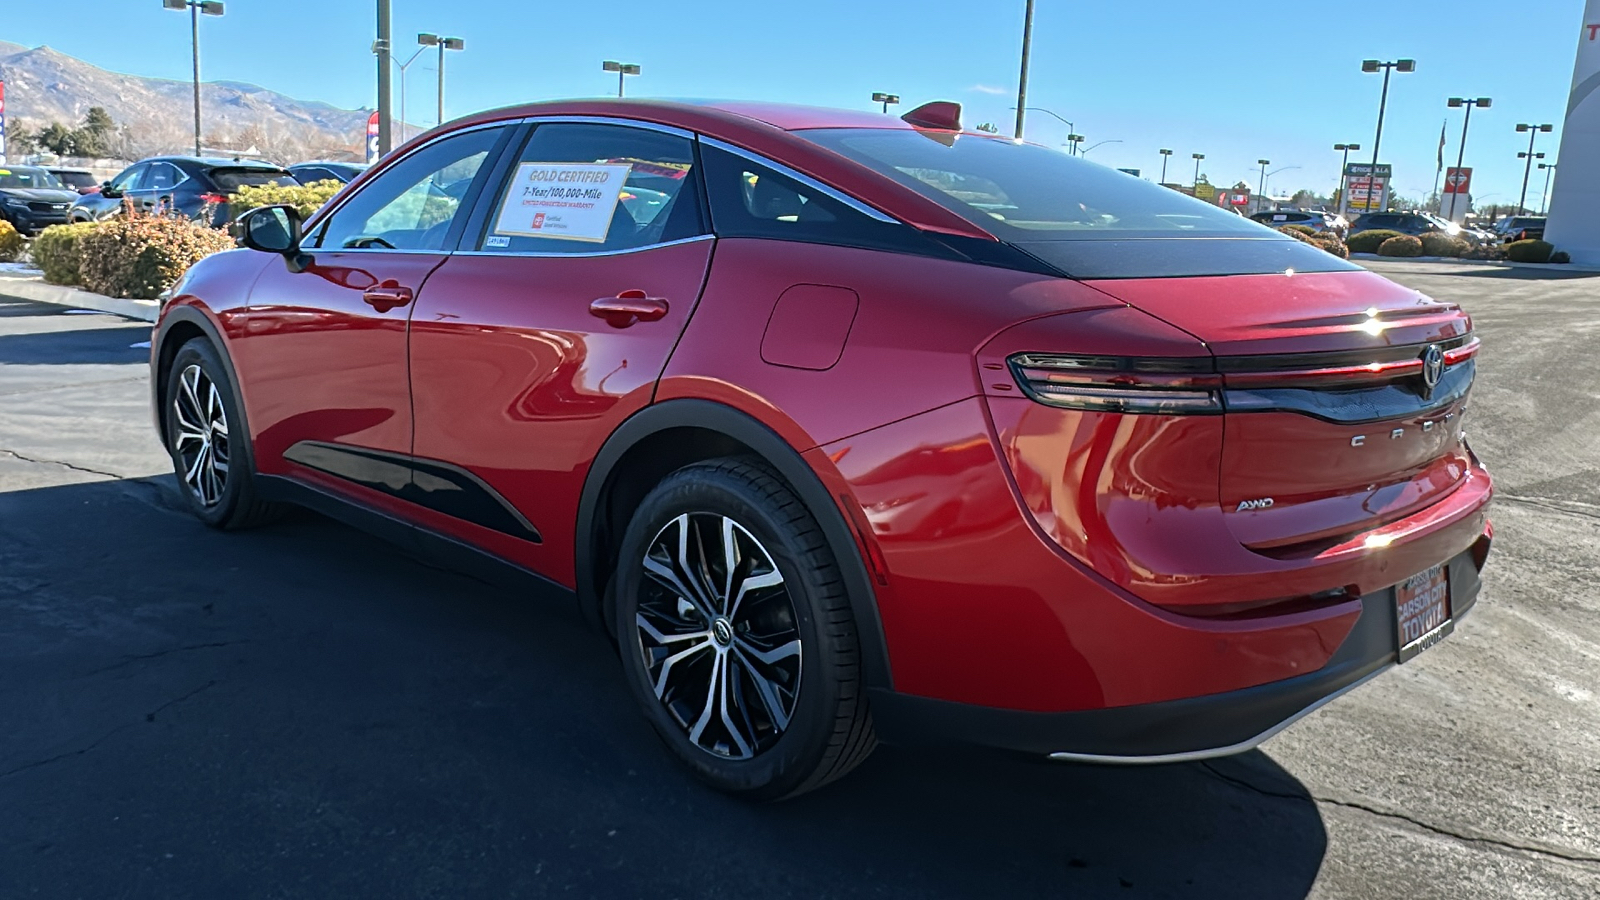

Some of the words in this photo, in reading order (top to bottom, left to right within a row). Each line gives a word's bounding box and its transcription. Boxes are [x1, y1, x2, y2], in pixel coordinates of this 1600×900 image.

[530, 170, 557, 181] GOLD
[558, 171, 608, 183] CERTIFIED
[523, 187, 602, 199] 7-Year/100,000-Mile
[1236, 498, 1274, 512] AWD
[1398, 590, 1431, 622] CARSON
[1431, 580, 1447, 600] CITY
[1402, 602, 1444, 642] TOYOTA
